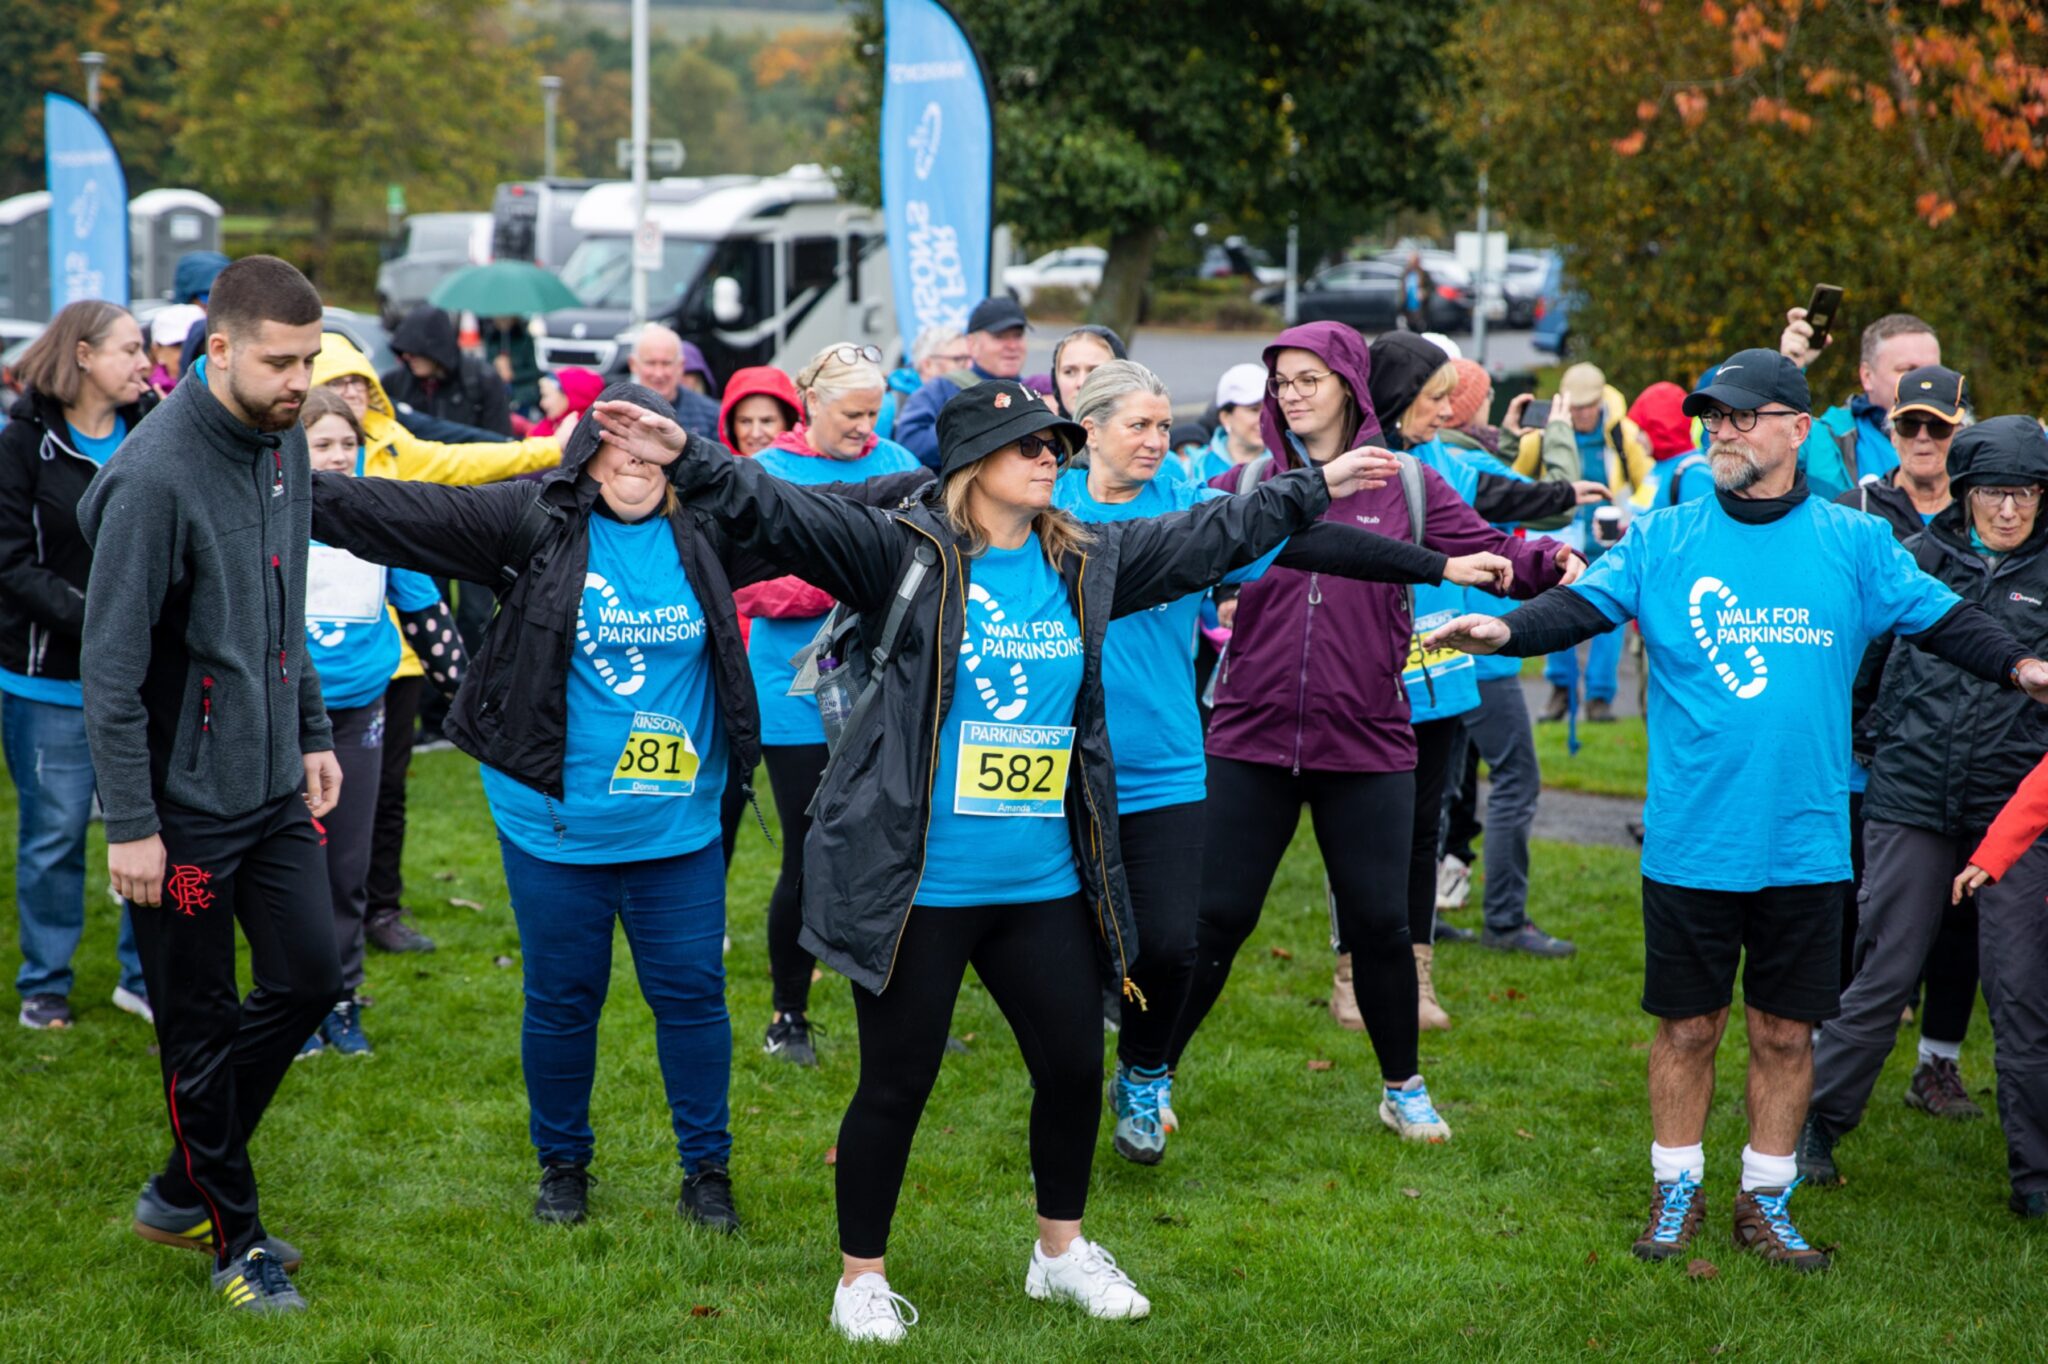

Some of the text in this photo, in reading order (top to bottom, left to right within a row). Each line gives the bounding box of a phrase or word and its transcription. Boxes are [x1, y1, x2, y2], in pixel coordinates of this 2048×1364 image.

[598, 604, 690, 625] WALK FOR
[1716, 608, 1810, 627] WALK FOR
[981, 621, 1068, 640] WALK FOR
[1717, 626, 1834, 647] PARKINSON'S
[982, 637, 1084, 660] PARKINSON'S
[970, 725, 1061, 745] PARKINSON'S
[978, 753, 1054, 792] 582
[632, 781, 660, 792] Donna
[997, 802, 1031, 813] Amanda
